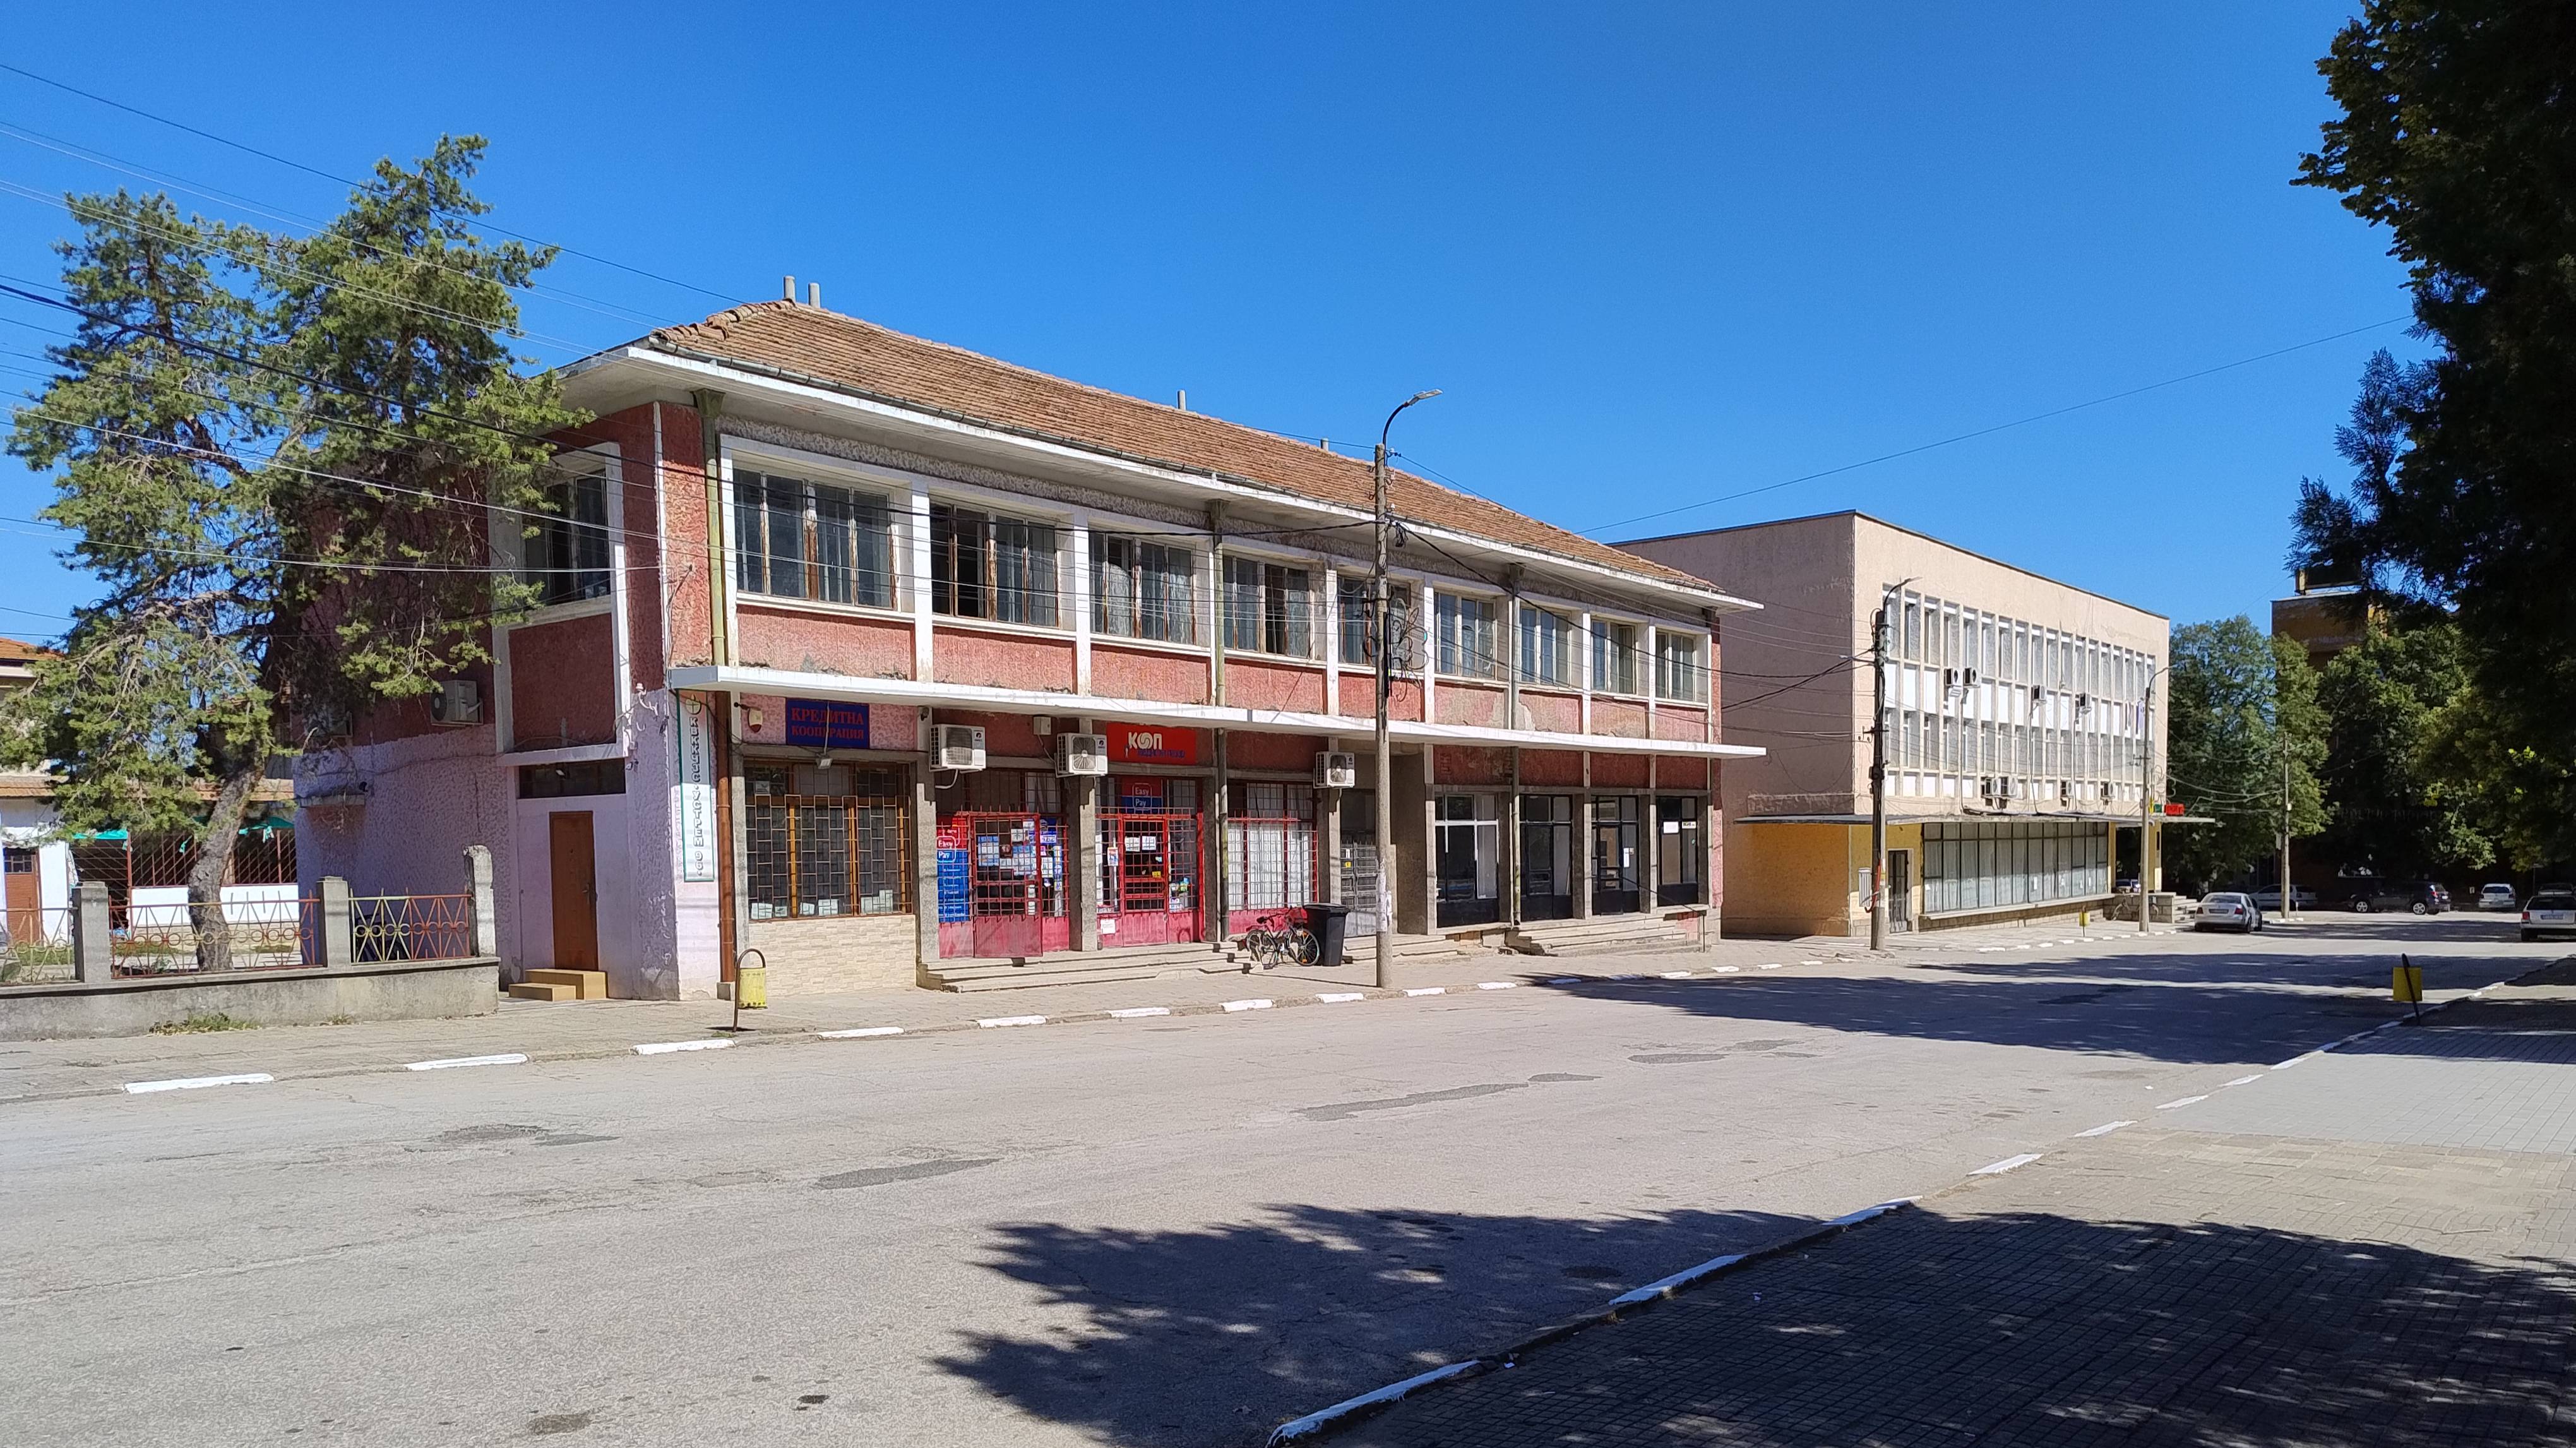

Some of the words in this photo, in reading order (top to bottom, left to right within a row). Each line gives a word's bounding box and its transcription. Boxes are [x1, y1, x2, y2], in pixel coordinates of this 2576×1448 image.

[791, 707, 864, 725] КРЕДИТНА
[1135, 786, 1149, 796] Easy
[1135, 798, 1146, 807] Pay
